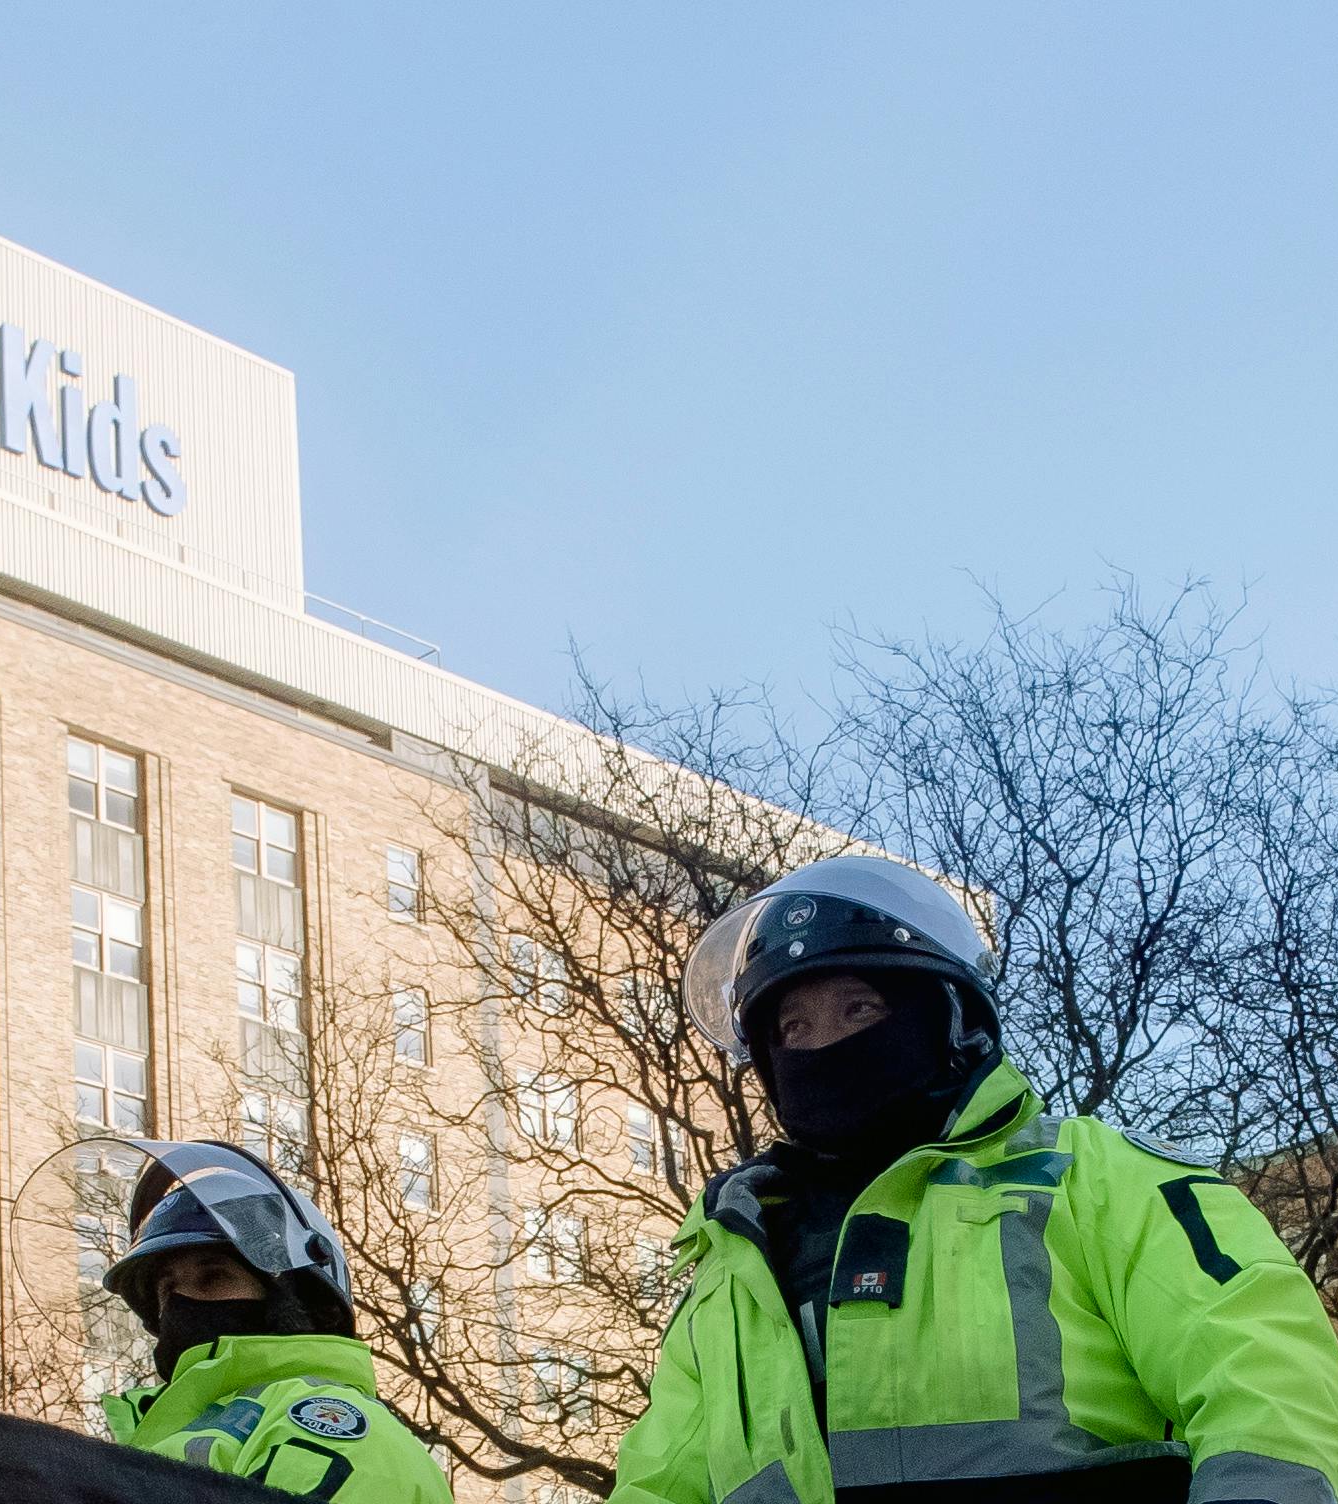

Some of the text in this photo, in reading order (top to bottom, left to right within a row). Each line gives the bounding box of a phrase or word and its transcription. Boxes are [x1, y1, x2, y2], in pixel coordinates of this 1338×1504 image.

[853, 1285, 883, 1294] 9710
[308, 1397, 363, 1419] TORONTO
[301, 1417, 344, 1435] POLICE
